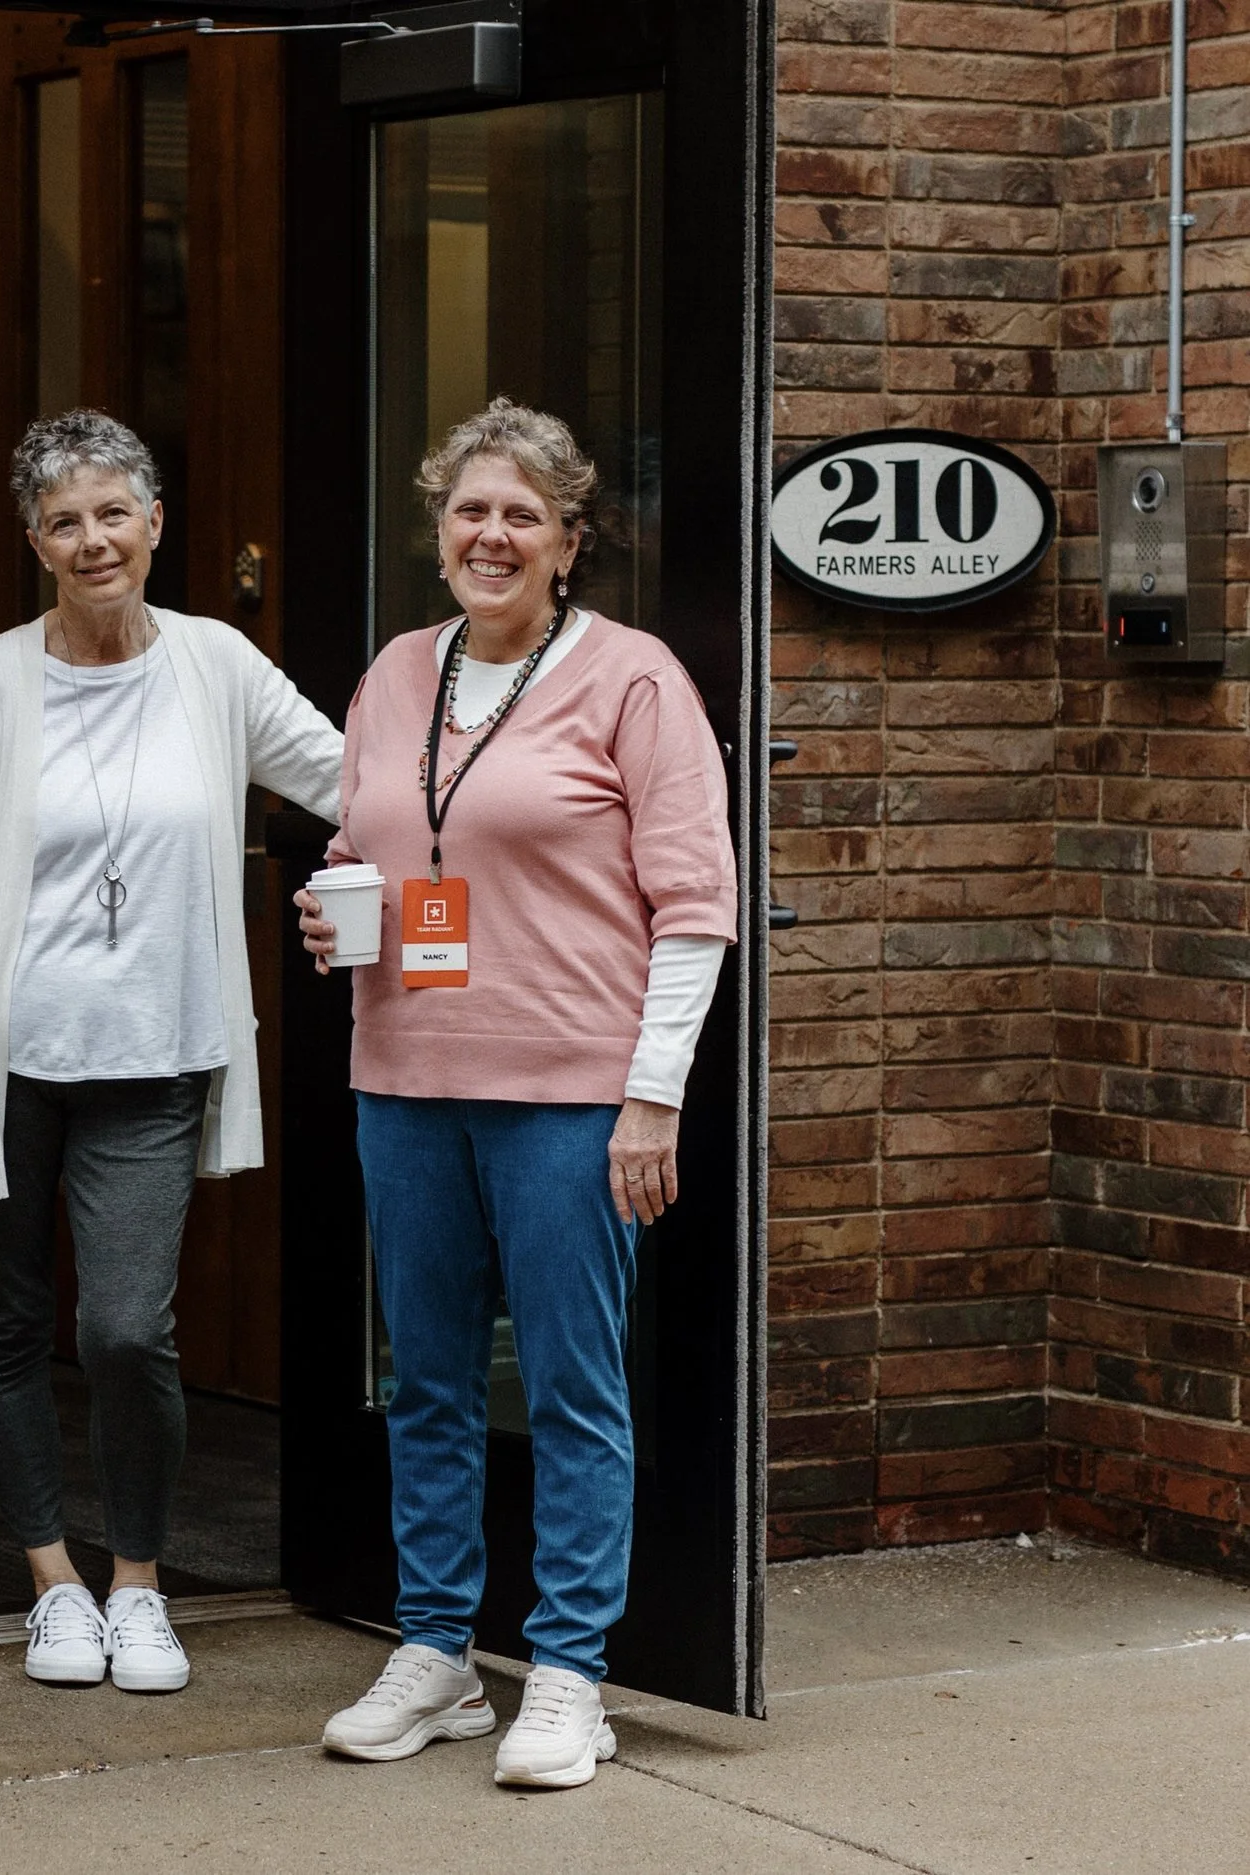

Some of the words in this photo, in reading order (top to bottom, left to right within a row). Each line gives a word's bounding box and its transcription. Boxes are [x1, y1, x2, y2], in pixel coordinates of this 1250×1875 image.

[819, 458, 999, 546] 210
[817, 556, 916, 576] FARMERS
[931, 555, 1000, 575] ALLEY
